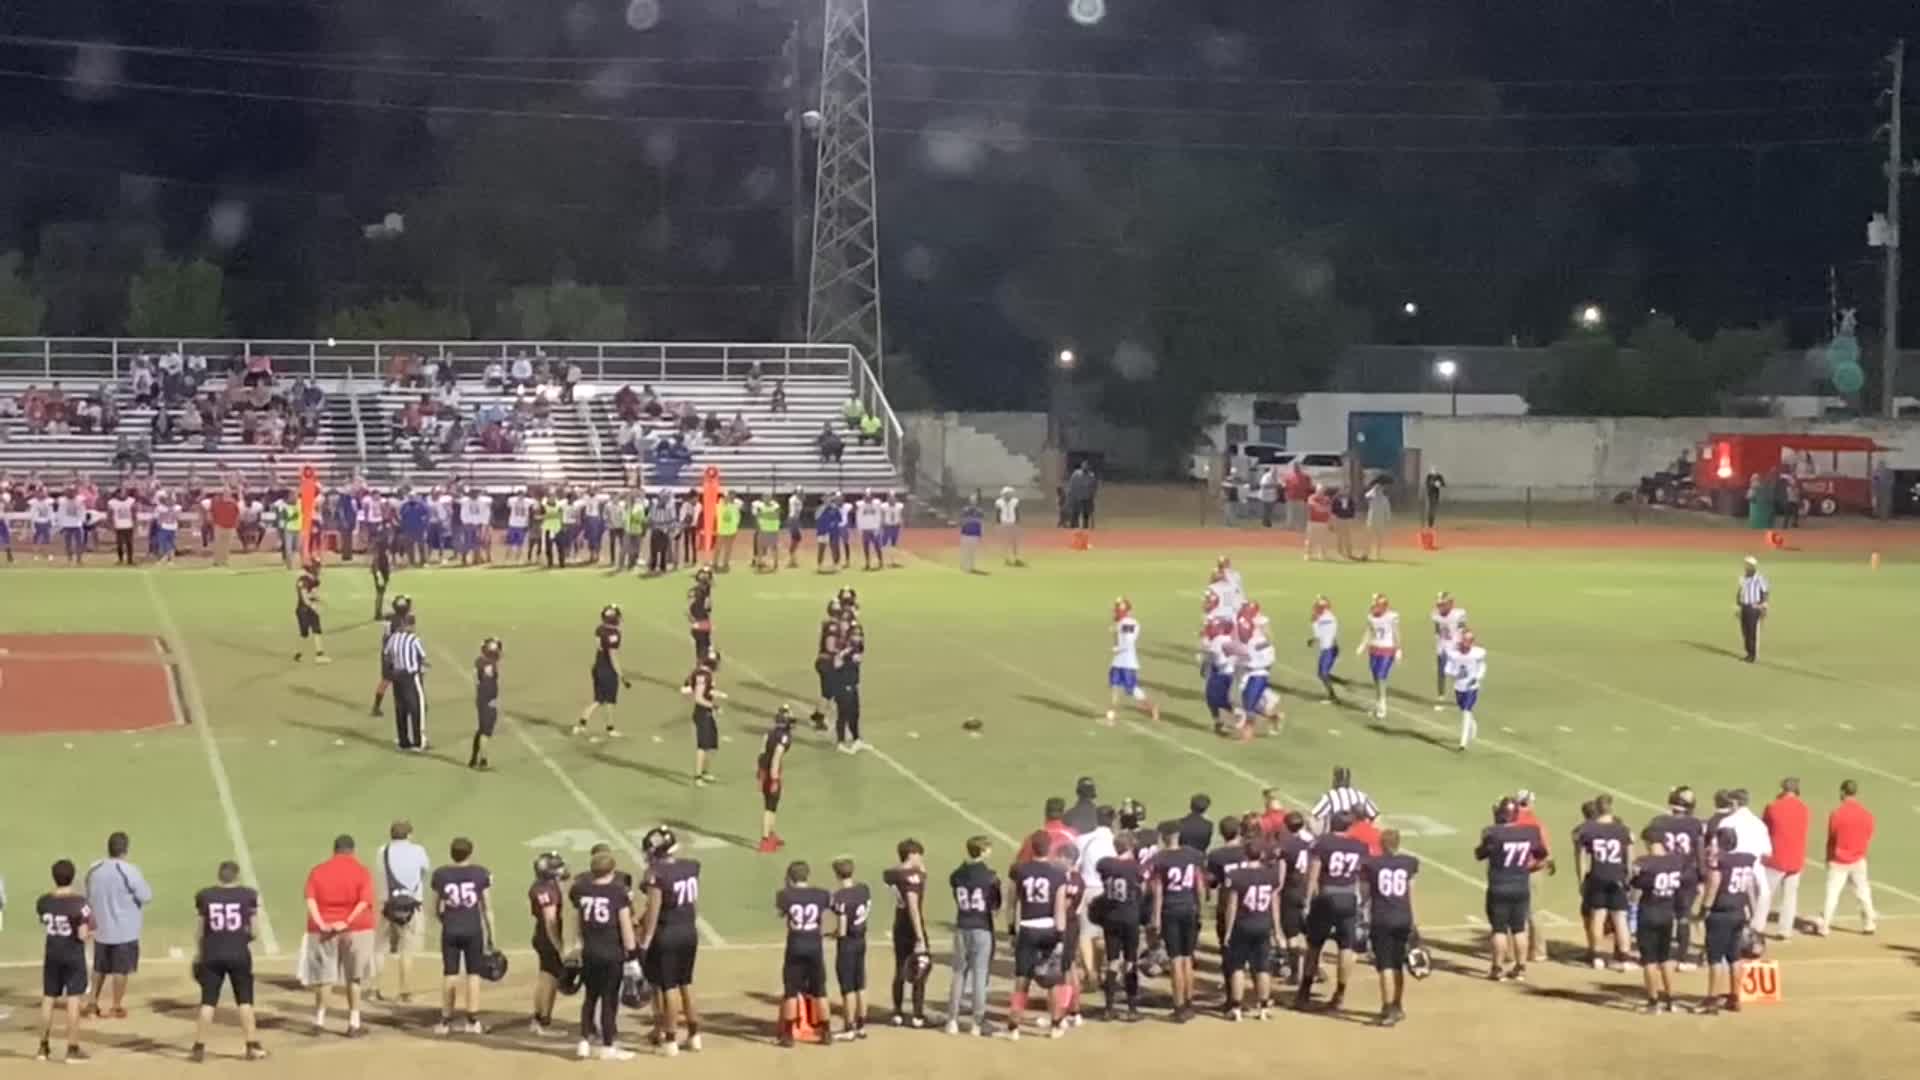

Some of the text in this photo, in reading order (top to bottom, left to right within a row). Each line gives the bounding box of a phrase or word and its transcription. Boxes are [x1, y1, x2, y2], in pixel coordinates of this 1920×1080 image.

[1329, 851, 1359, 877] 67
[1503, 842, 1531, 867] 77
[1593, 839, 1621, 864] 52
[1167, 863, 1195, 890] 24
[1378, 868, 1407, 896] 66
[444, 882, 477, 907] 35
[956, 886, 986, 911] 84
[1023, 877, 1050, 903] 13
[1243, 885, 1272, 912] 45
[209, 903, 242, 931] 55
[789, 904, 818, 931] 32
